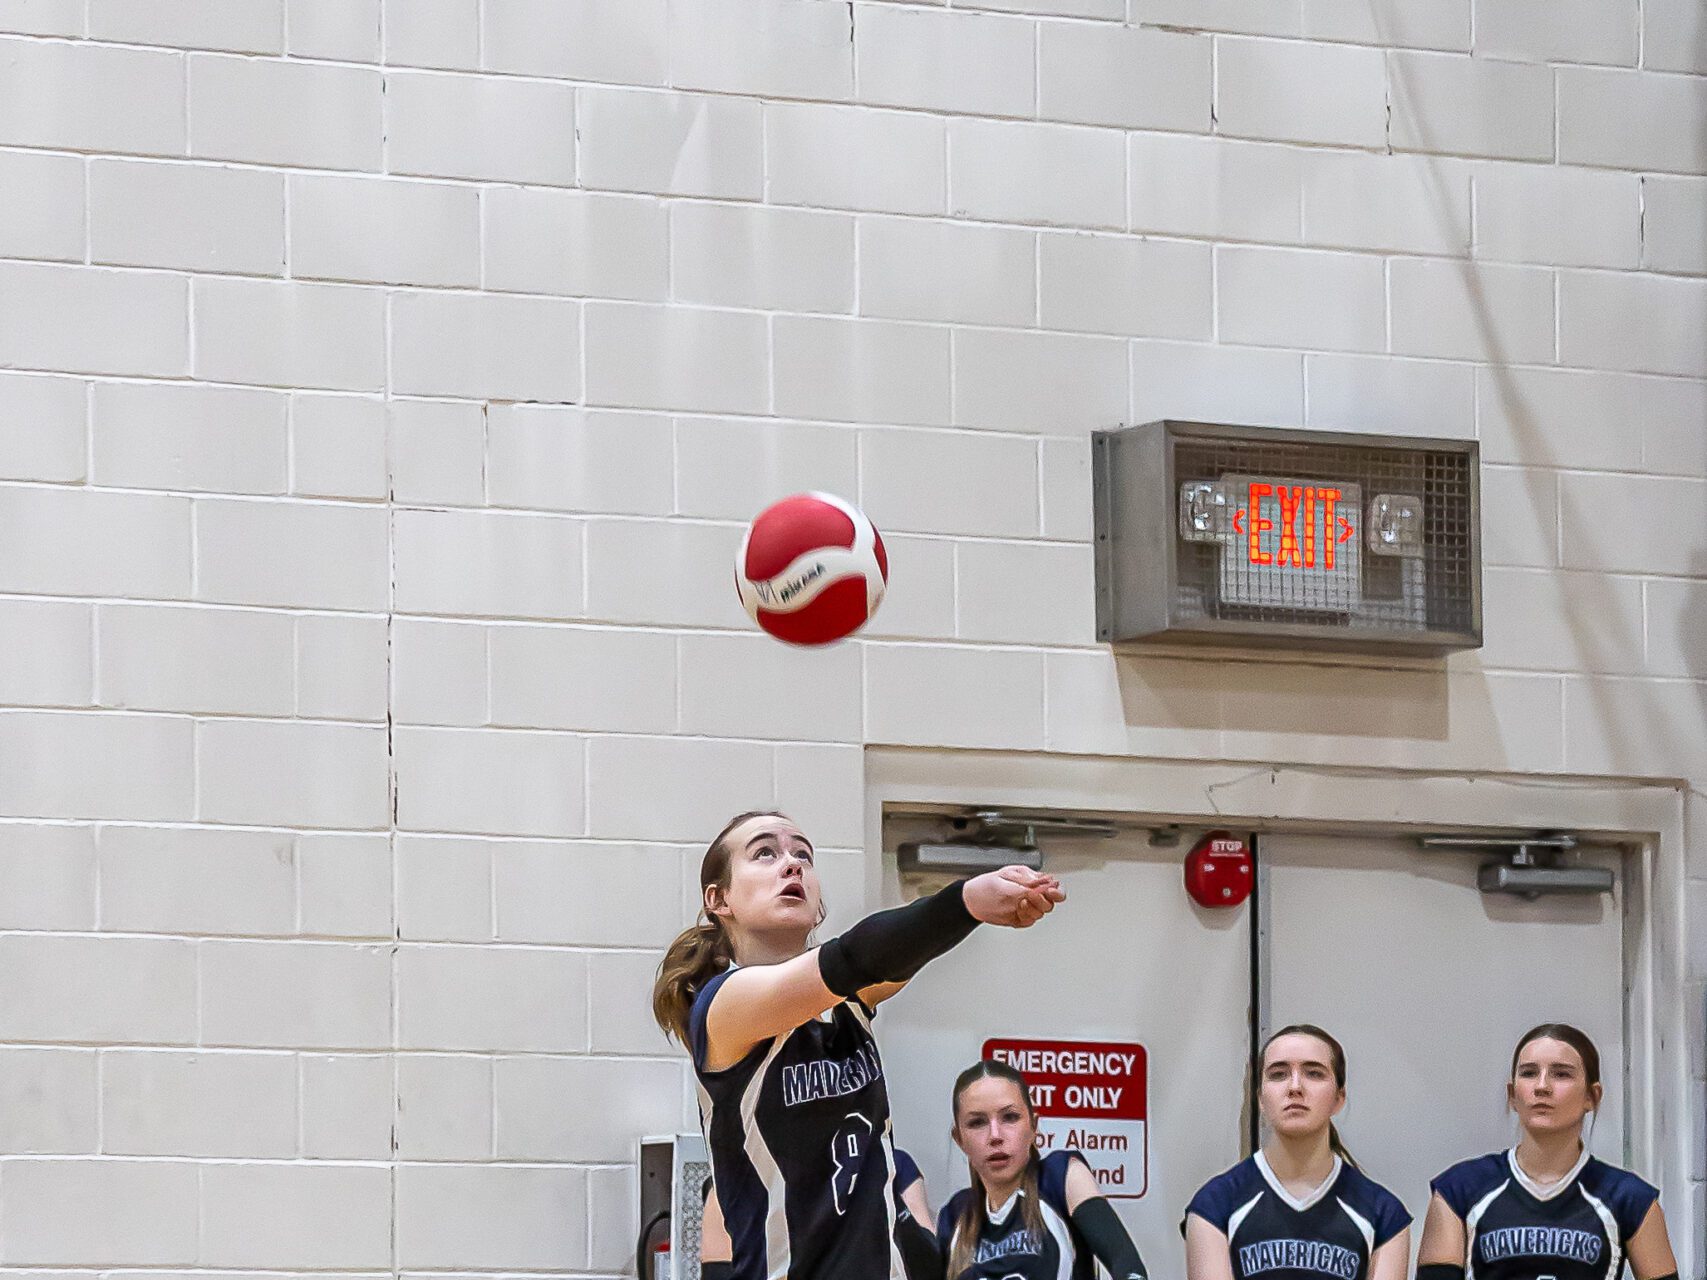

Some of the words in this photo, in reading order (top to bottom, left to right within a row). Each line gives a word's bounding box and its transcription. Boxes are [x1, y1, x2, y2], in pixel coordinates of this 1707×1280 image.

[1248, 482, 1343, 570] EXIT
[1211, 840, 1243, 852] STOP
[992, 1049, 1137, 1077] EMERGENCY
[1028, 1085, 1056, 1107] XIT
[1064, 1085, 1123, 1110] ONLY
[1065, 1129, 1128, 1153] Alarm
[831, 1112, 873, 1217] 8
[1479, 1226, 1603, 1265] MAVERICKS
